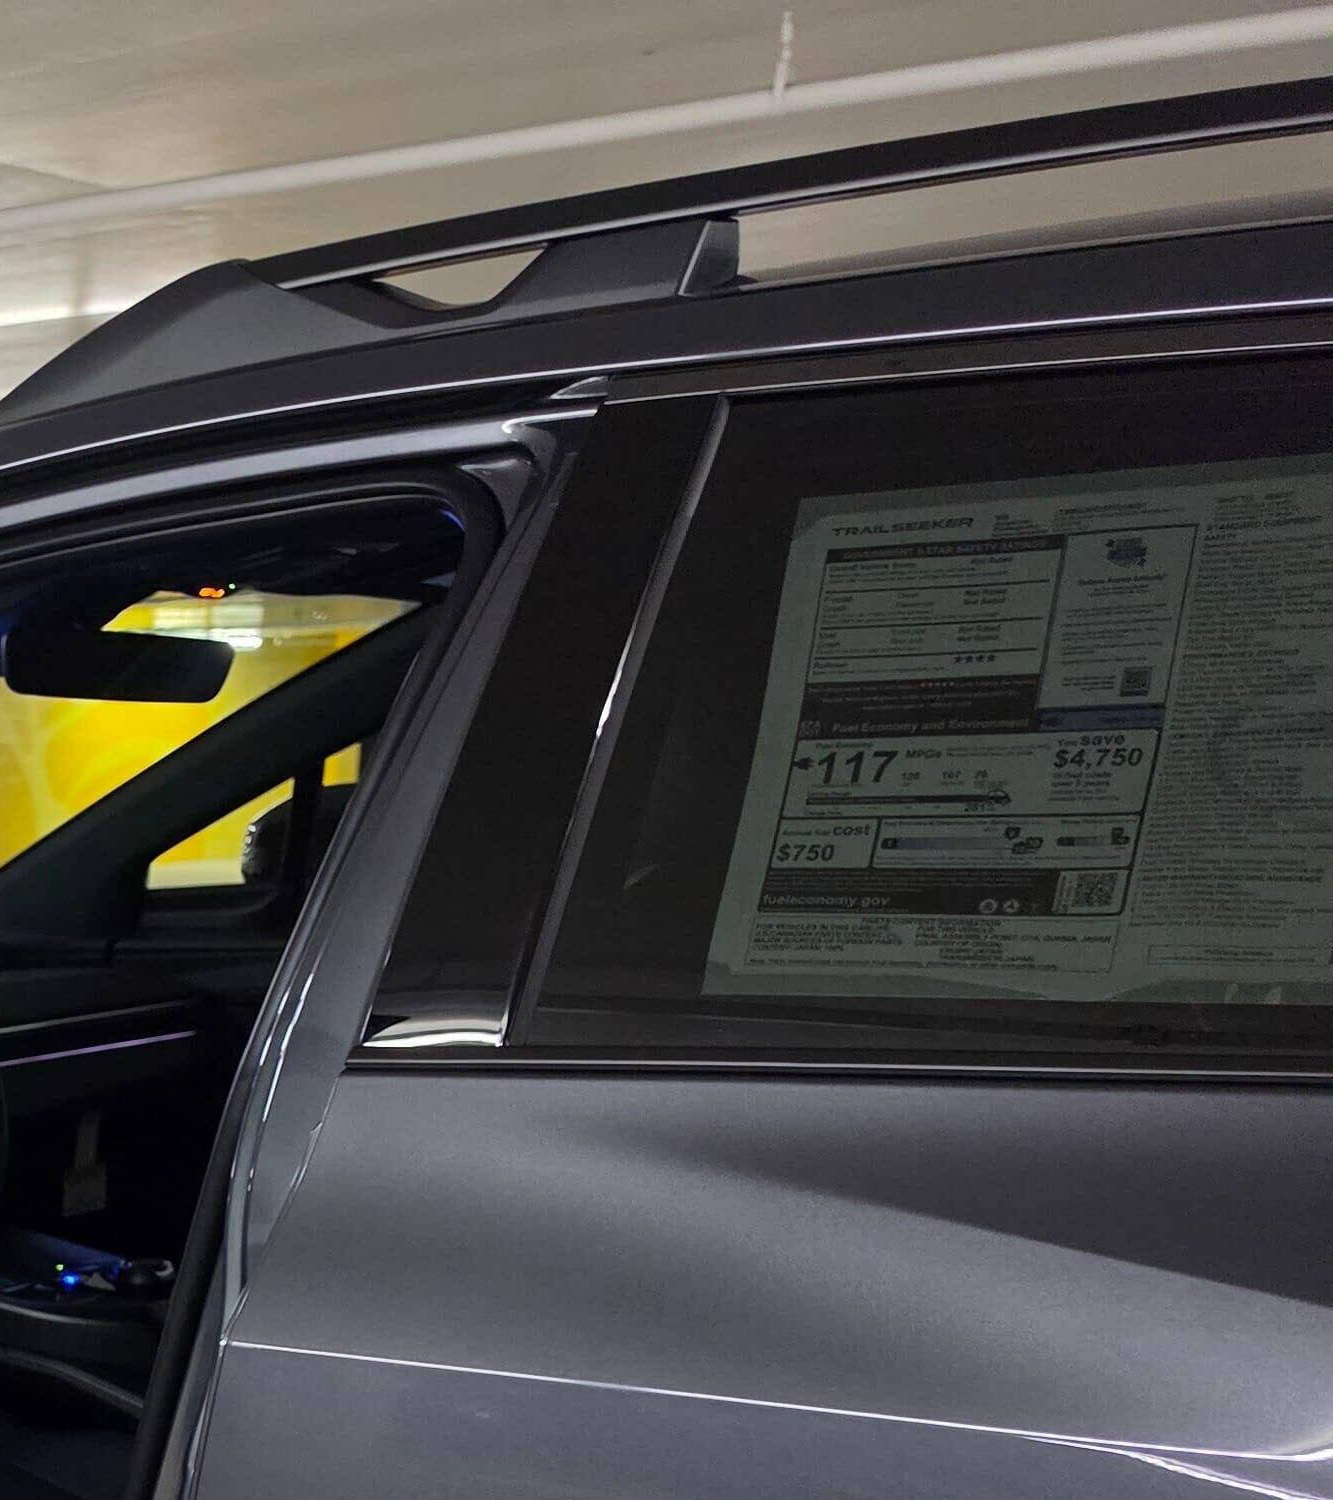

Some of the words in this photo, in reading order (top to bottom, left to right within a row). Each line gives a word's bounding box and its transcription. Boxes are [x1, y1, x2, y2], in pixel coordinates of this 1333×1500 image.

[833, 723, 859, 733] Fuel
[861, 720, 919, 734] Economy
[921, 720, 945, 730] and
[948, 718, 1030, 730] Environment
[1080, 735, 1126, 746] save
[1053, 747, 1144, 770] $4,750
[817, 750, 900, 785] 117
[833, 824, 872, 837] cost
[776, 844, 836, 862] $750
[762, 894, 891, 909] fueleconomy.gov
